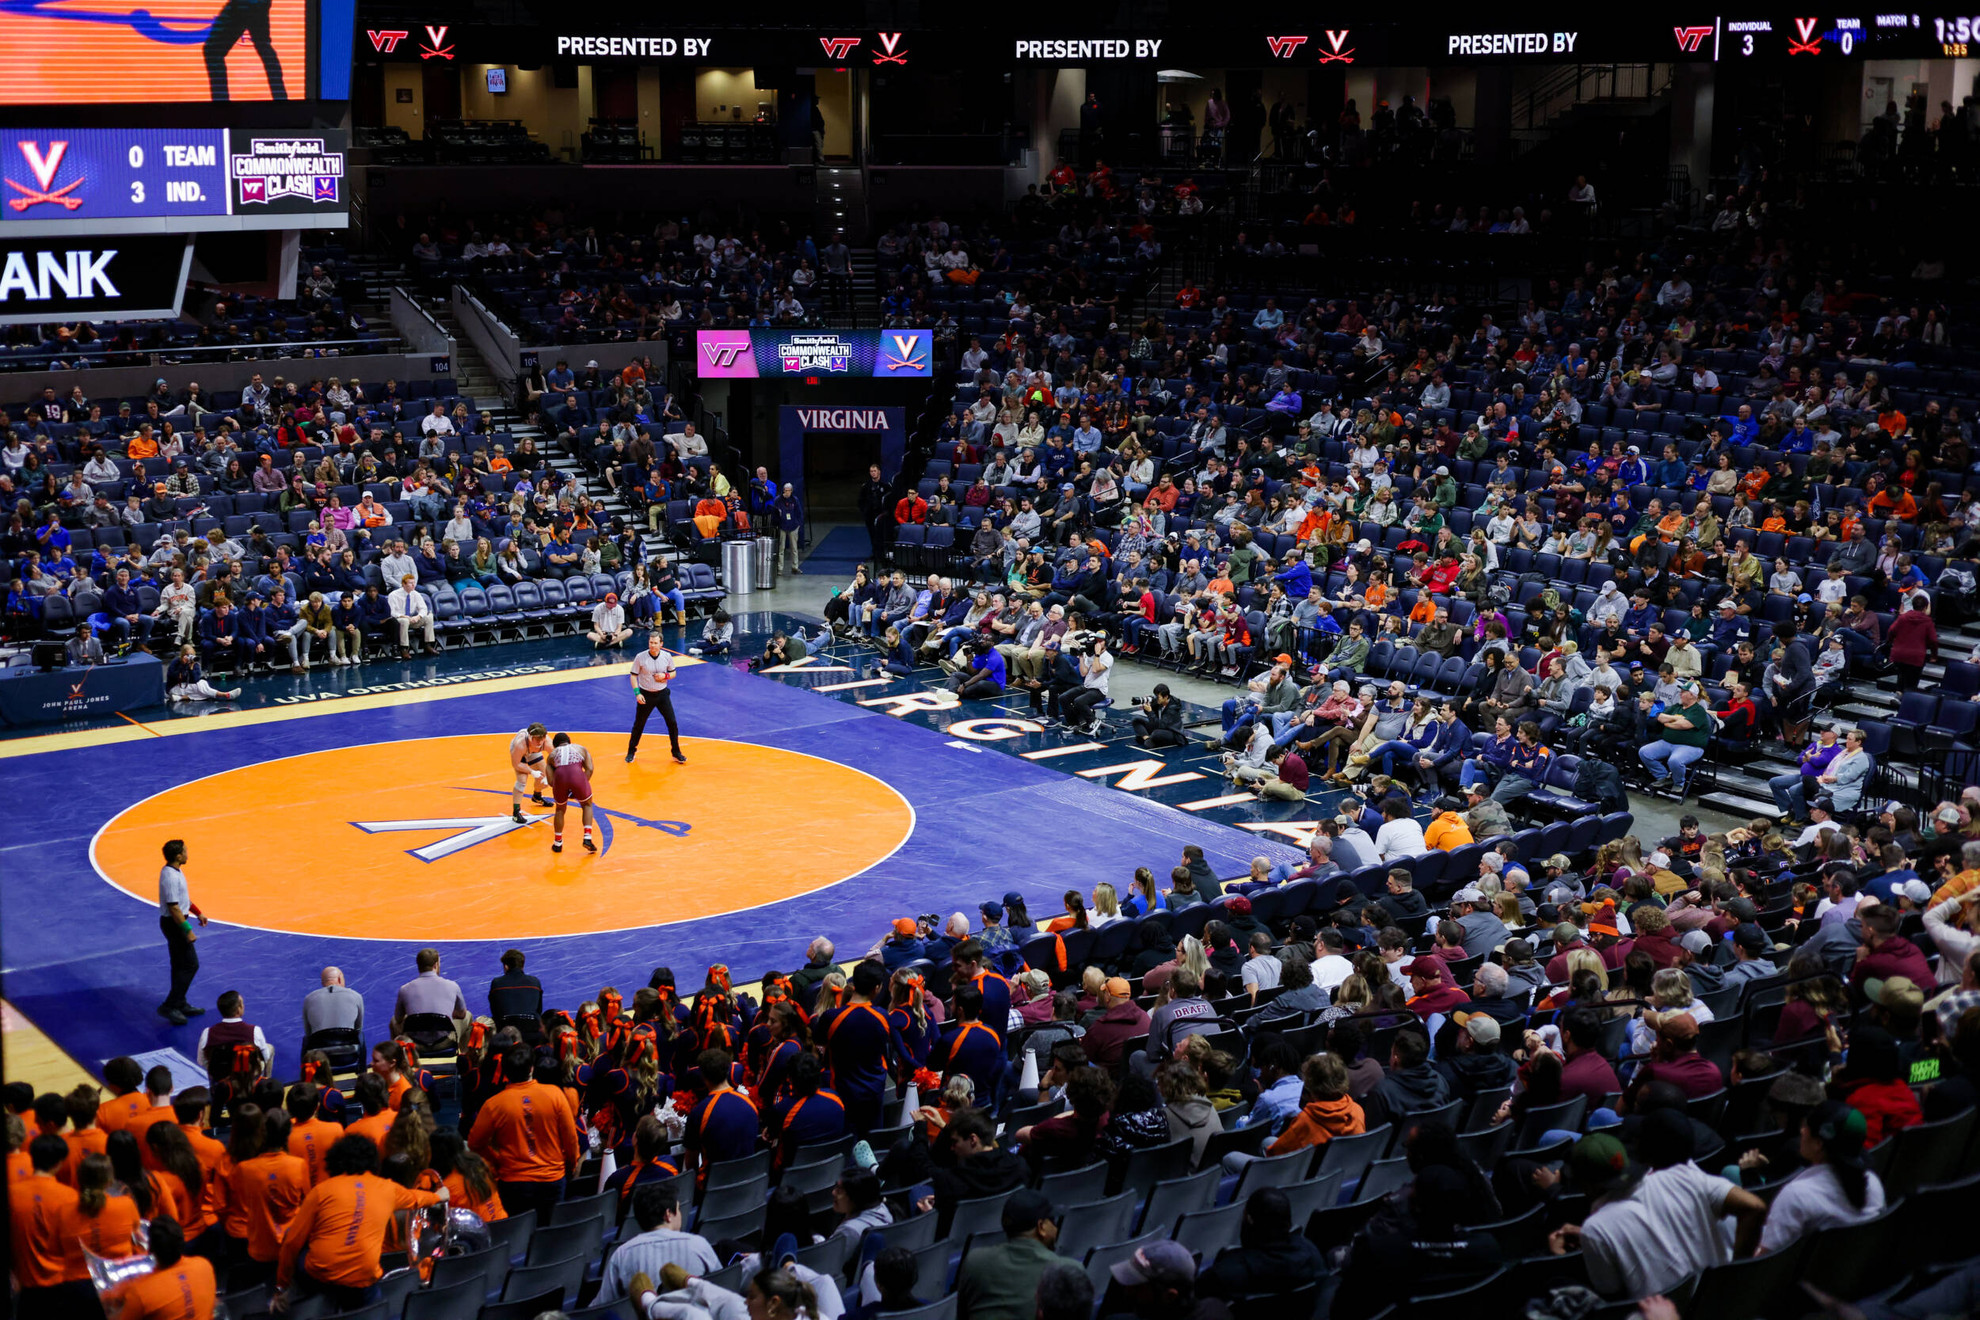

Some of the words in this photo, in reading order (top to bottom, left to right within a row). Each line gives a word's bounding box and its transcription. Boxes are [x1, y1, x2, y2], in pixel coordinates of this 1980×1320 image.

[1728, 21, 1772, 32] INDIVIDUAL
[1836, 18, 1860, 30] TEAM
[1876, 15, 1907, 27] MATCH
[557, 36, 677, 57] PRESENTED
[683, 37, 712, 58] BY
[1015, 38, 1130, 60] PRESENTED
[1133, 38, 1162, 59] BY
[1447, 34, 1548, 56] PRESENTED
[1552, 32, 1579, 54] BY
[1741, 34, 1755, 56] 3
[1840, 31, 1854, 55] 0
[128, 146, 144, 168] 0
[163, 145, 216, 167] TEAM
[254, 141, 321, 158] Smithfield
[235, 157, 341, 176] COMMONWEALTH
[130, 181, 146, 204] 3
[166, 181, 207, 203] IND.
[267, 176, 313, 196] CLASH
[781, 345, 851, 356] COMMONWEALTH
[793, 336, 836, 346] Smithfield
[702, 342, 750, 366] VT
[800, 356, 830, 368] CLASH
[434, 362, 449, 372] 104
[797, 409, 890, 429] VIRGINIA
[274, 691, 340, 705] UVA
[346, 662, 557, 697] ORTHOPEDICS
[42, 701, 62, 709] JOHN
[64, 698, 84, 707] PAUL
[85, 695, 110, 704] JONES
[62, 704, 89, 712] ARENA
[1174, 1003, 1209, 1019] DRAFT
